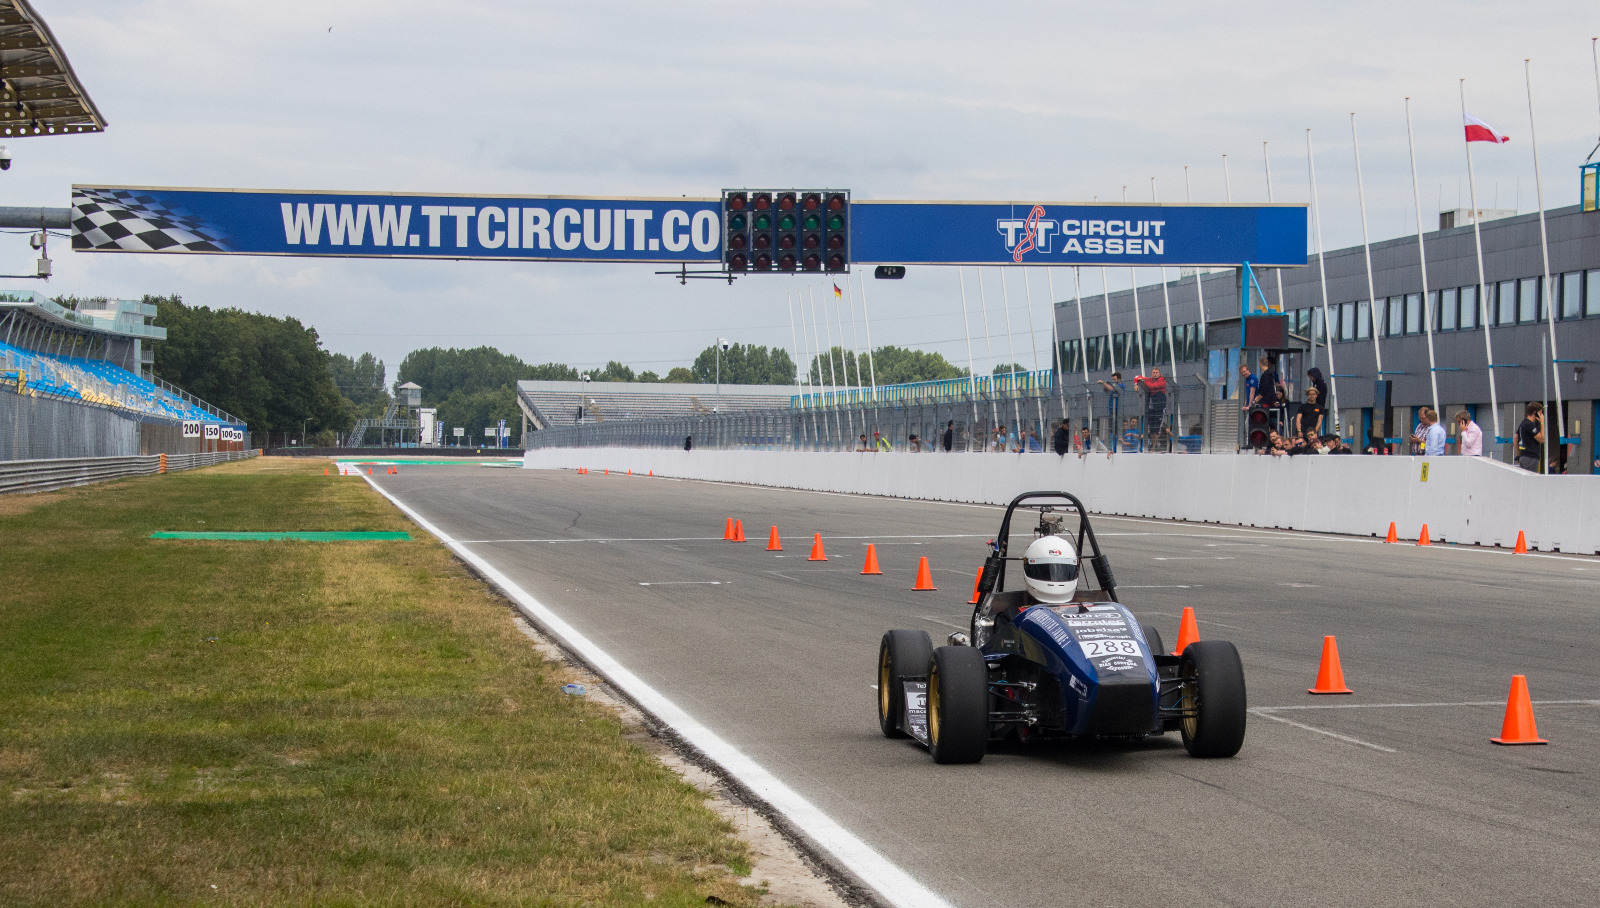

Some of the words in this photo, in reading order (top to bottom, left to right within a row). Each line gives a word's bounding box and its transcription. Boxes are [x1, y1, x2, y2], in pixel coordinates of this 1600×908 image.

[280, 202, 753, 253] WWW.TTCIRCUIT.CO
[1062, 219, 1166, 237] CIRCUIT
[1062, 238, 1164, 255] ASSEN
[184, 424, 199, 434] 200
[206, 428, 218, 436] 150
[1086, 640, 1136, 656] 288
